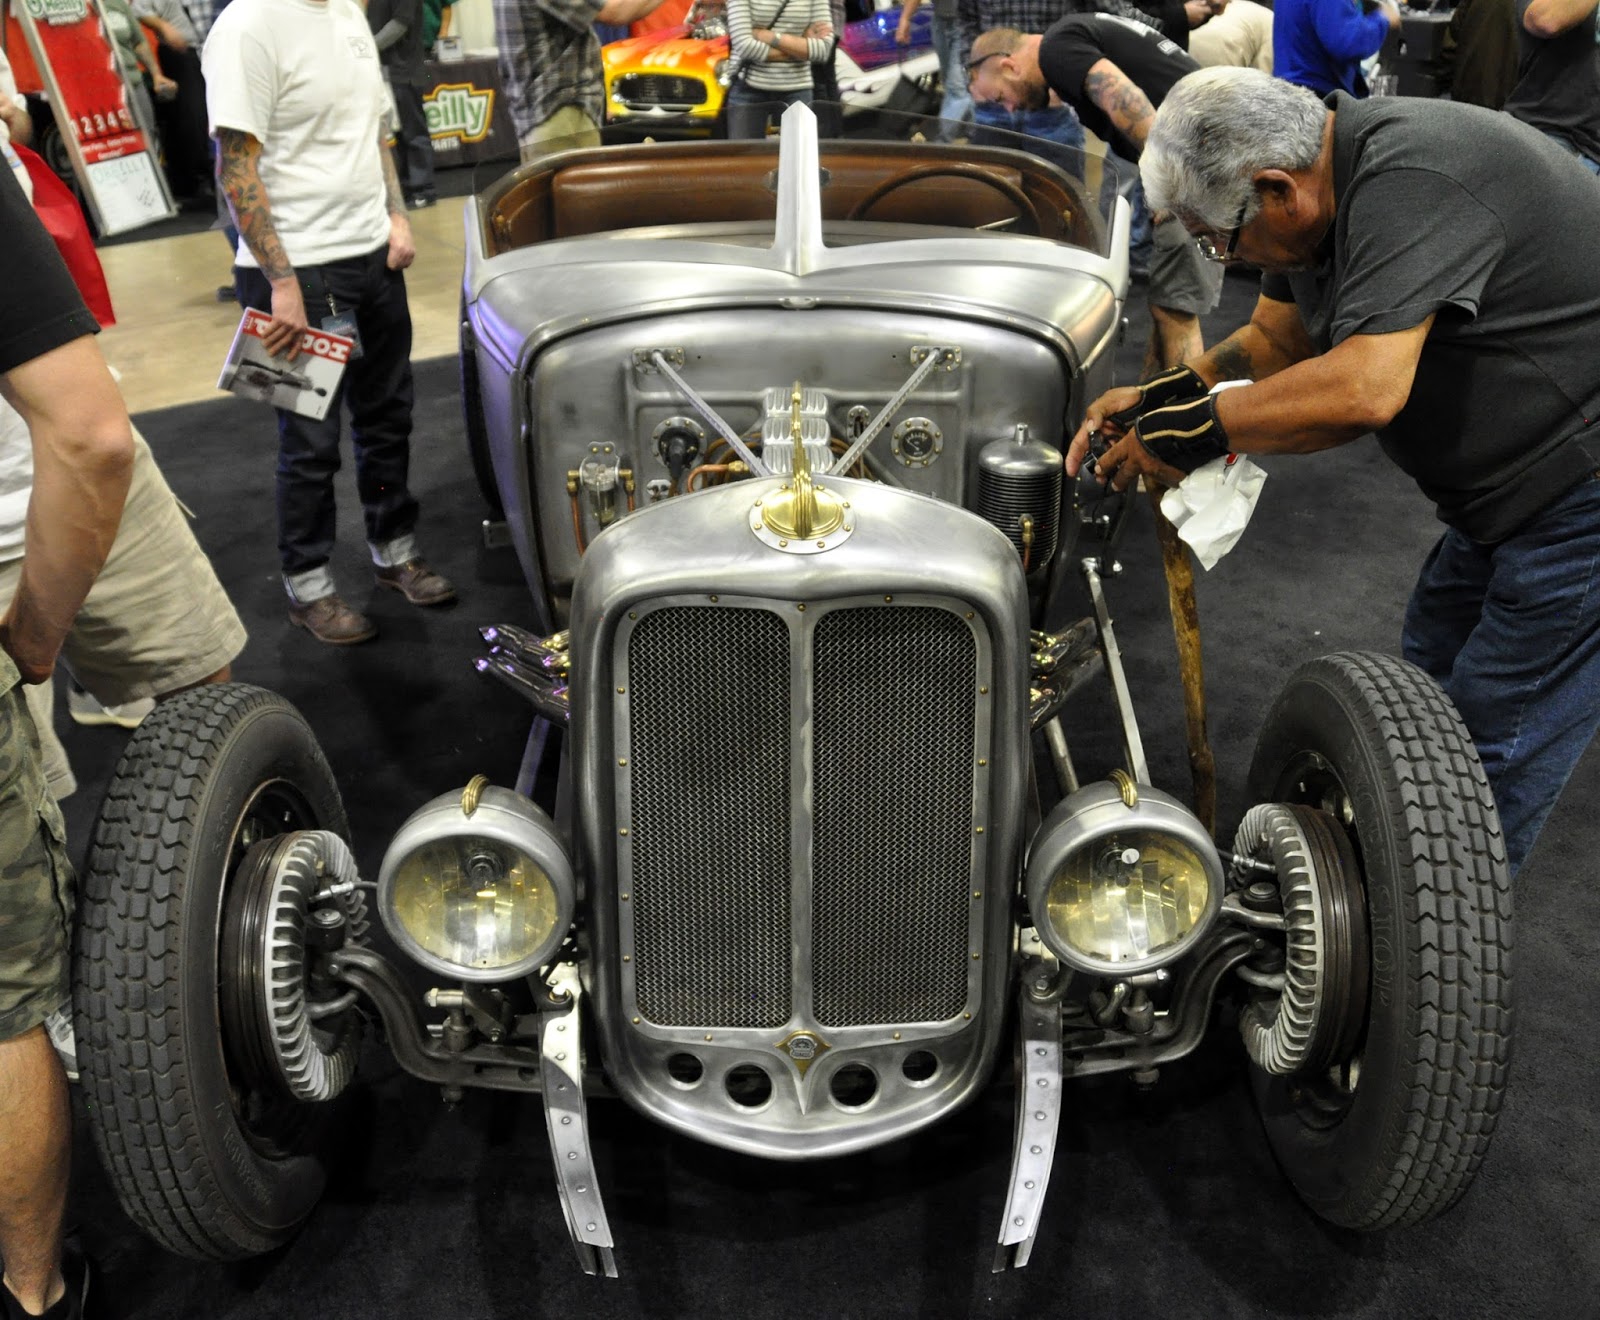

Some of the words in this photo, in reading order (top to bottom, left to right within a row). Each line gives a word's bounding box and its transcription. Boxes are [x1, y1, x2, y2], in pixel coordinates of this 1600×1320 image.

[80, 116, 94, 134] 2
[93, 113, 106, 132] 3
[107, 111, 119, 127] 4
[425, 93, 484, 130] eilly
